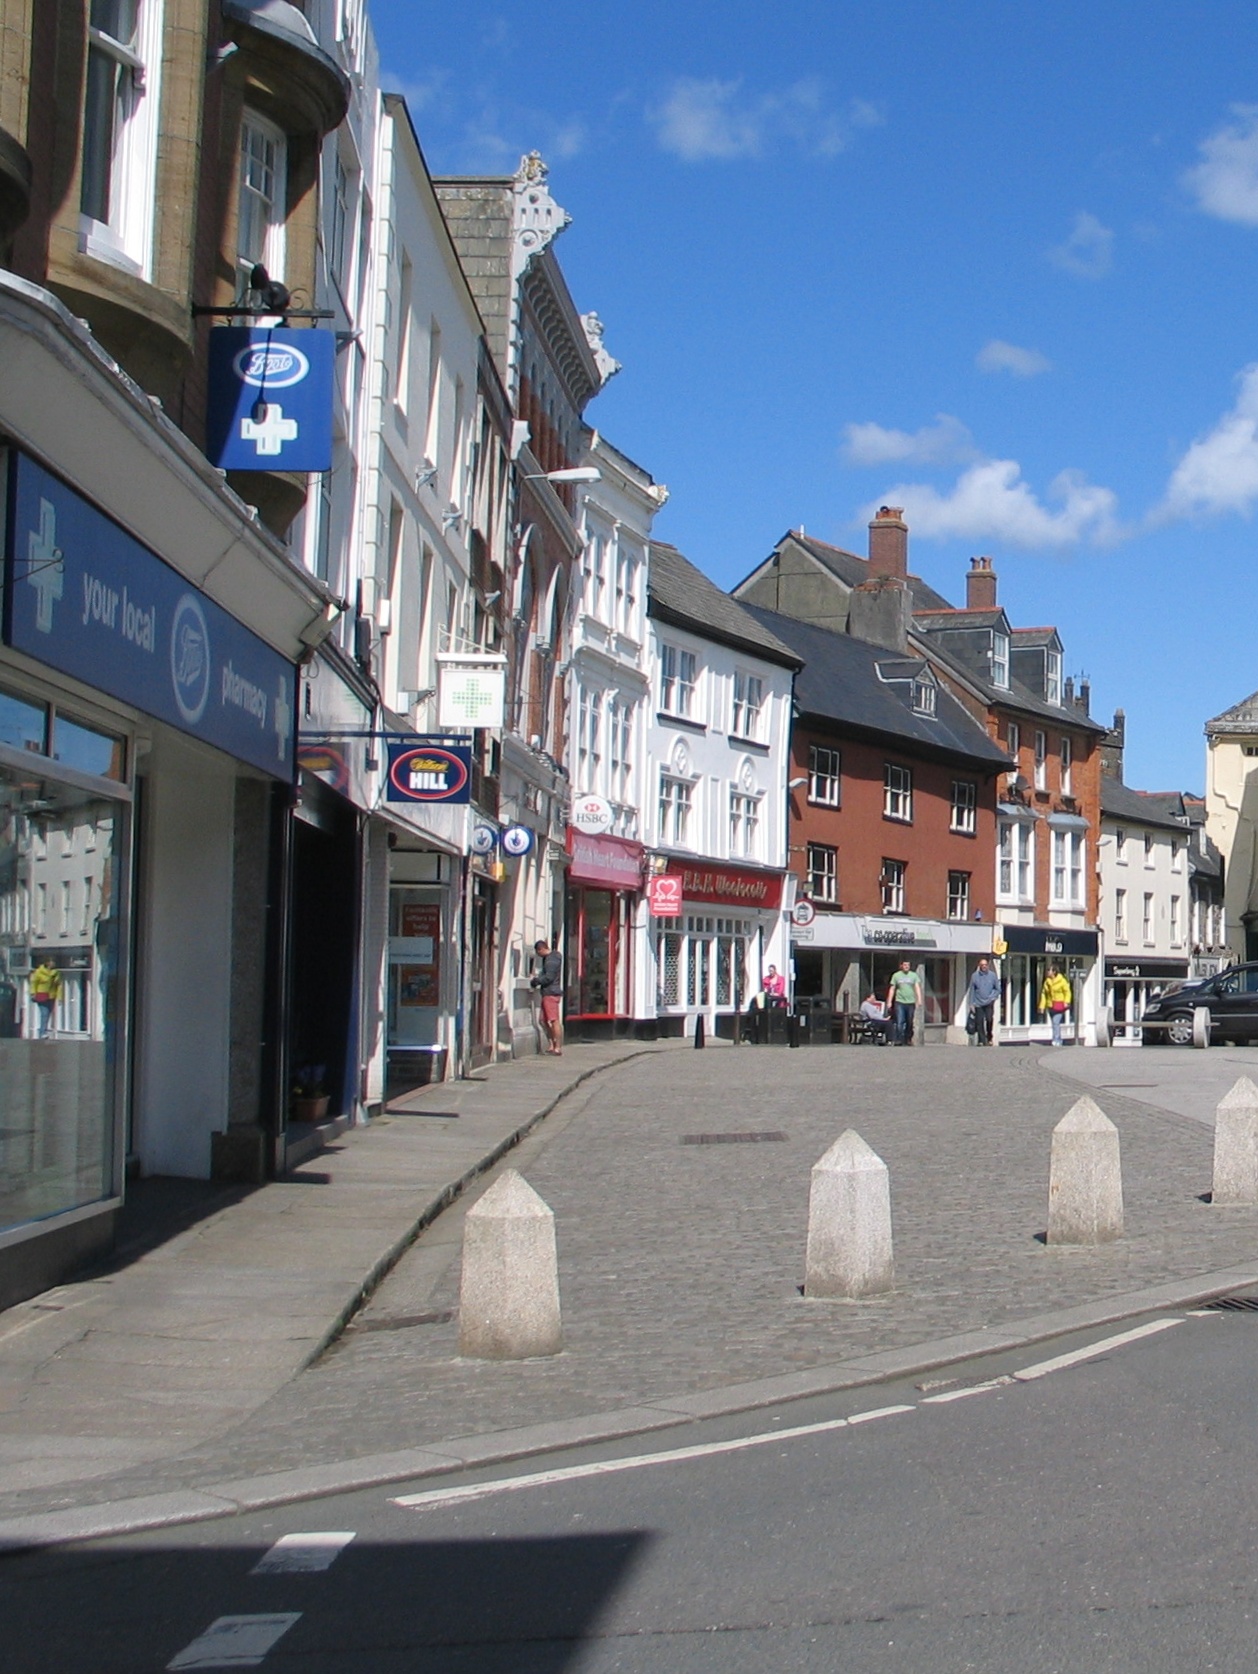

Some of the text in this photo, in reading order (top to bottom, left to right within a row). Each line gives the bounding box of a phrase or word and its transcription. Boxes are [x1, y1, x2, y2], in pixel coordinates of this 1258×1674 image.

[246, 353, 293, 376] Boots
[82, 572, 119, 628] your
[122, 585, 156, 653] local
[221, 659, 268, 729] pharmacy
[409, 772, 448, 790] HILL
[576, 813, 608, 824] HSBC
